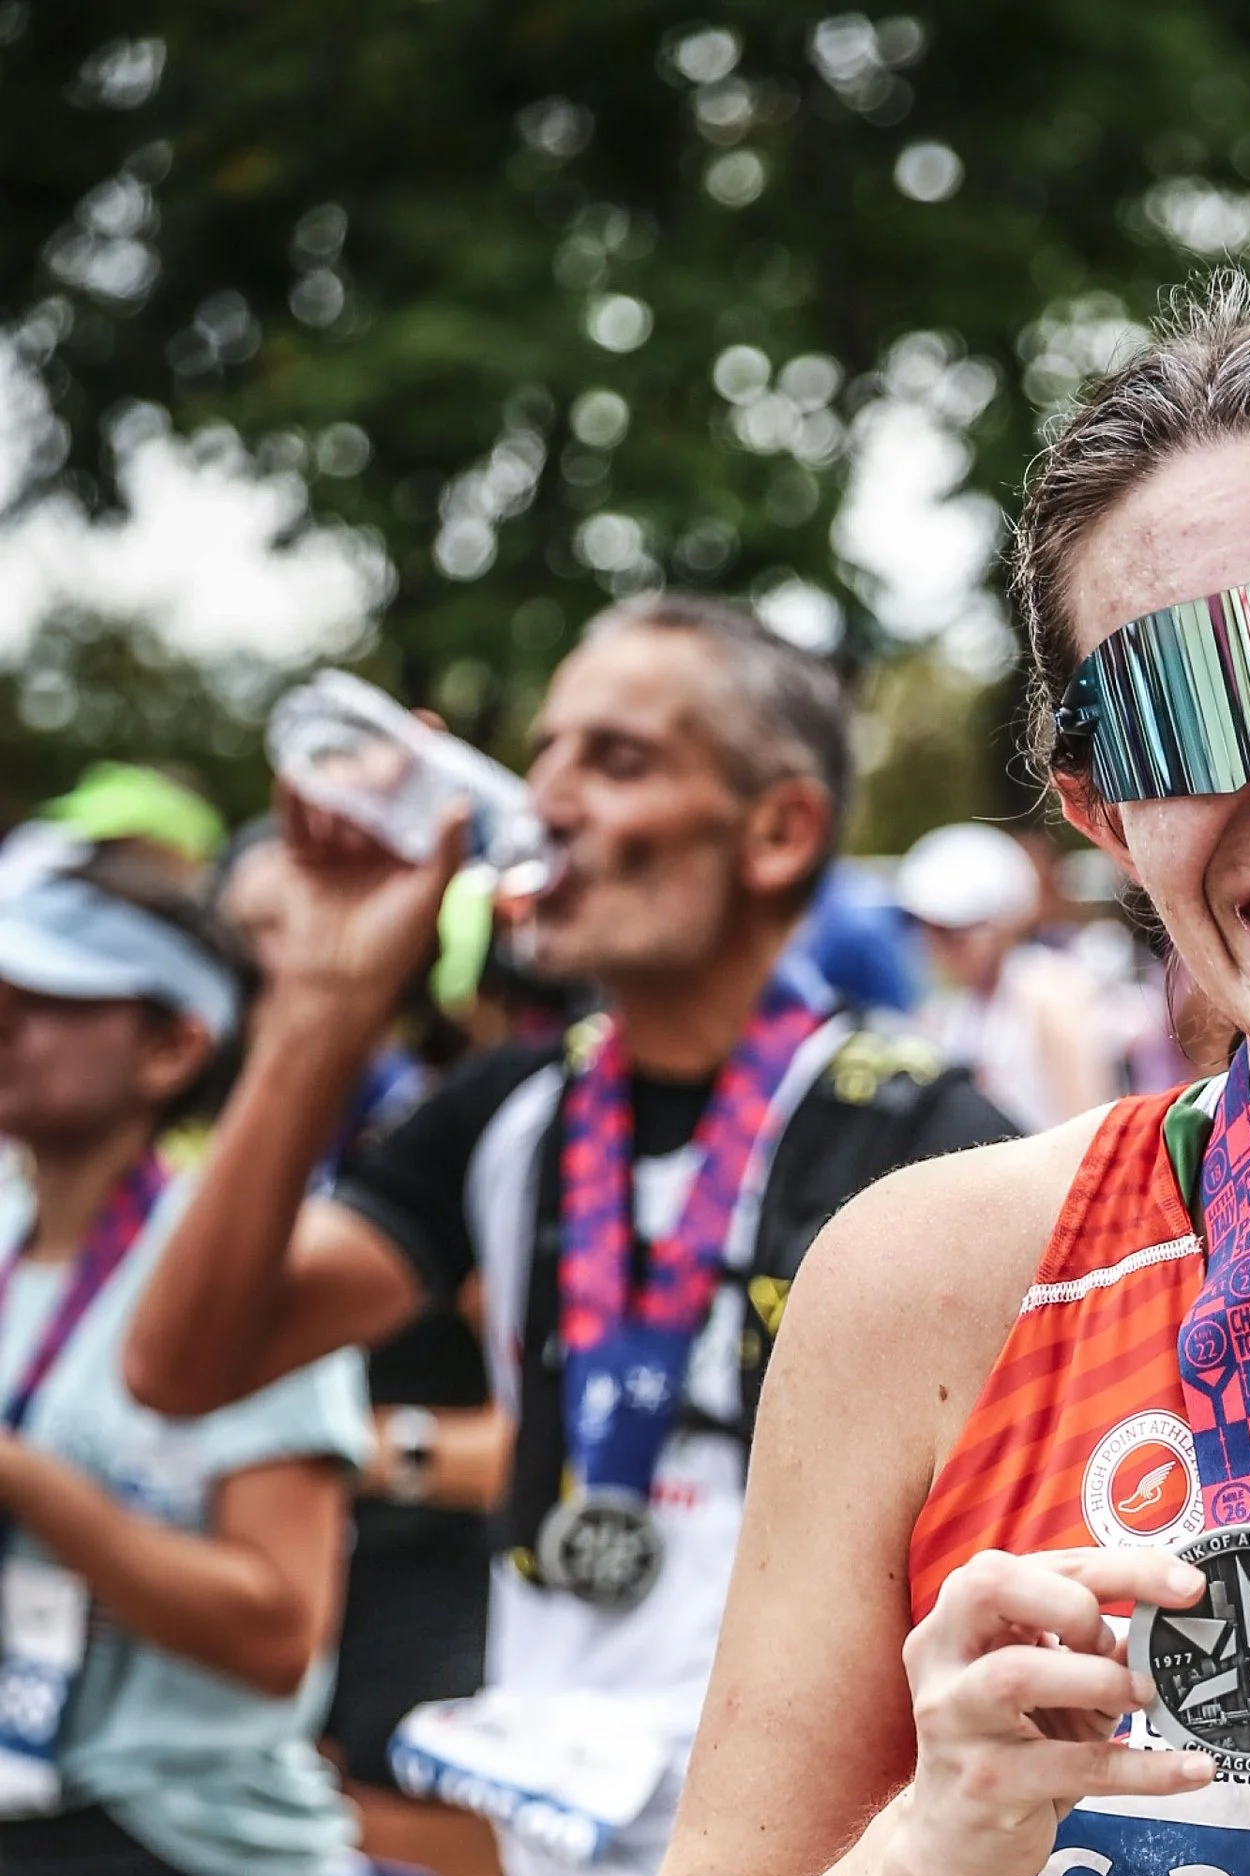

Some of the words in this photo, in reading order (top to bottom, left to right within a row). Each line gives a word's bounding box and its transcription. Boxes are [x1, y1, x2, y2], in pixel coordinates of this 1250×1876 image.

[1196, 1340, 1218, 1361] 22
[1090, 1465, 1108, 1512] HIGH
[1102, 1421, 1146, 1463] POINT
[1149, 1419, 1201, 1484] ATHLE
[1223, 1501, 1247, 1523] 26
[1181, 1545, 1206, 1565] NK
[1209, 1534, 1231, 1551] OF
[1153, 1652, 1193, 1669] 1977
